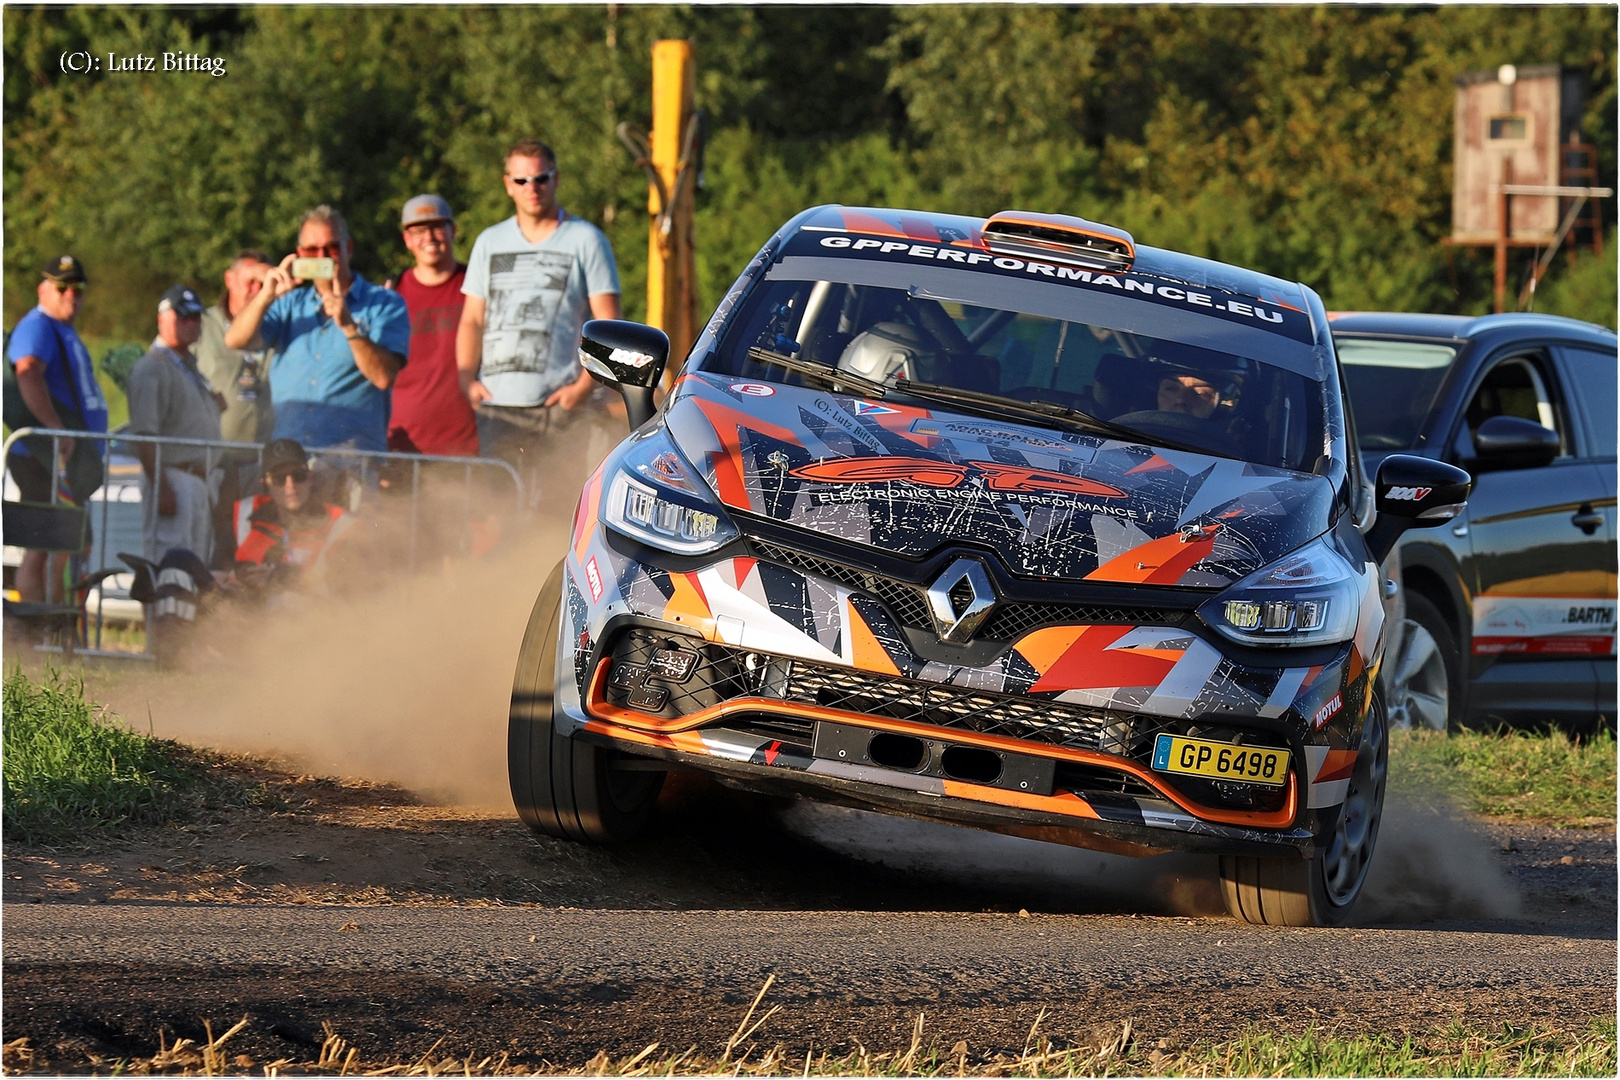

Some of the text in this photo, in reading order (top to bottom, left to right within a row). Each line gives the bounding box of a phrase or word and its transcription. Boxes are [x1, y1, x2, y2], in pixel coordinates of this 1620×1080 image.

[819, 236, 1285, 324] GPPERFORMANCE.EU
[818, 488, 1139, 519] ELECTRONIC ENGINE PERFORMANCE
[586, 559, 602, 601] MOTUL
[1315, 694, 1343, 728] MOTUL
[1158, 755, 1165, 765] L
[1180, 744, 1277, 778] GP 6498
